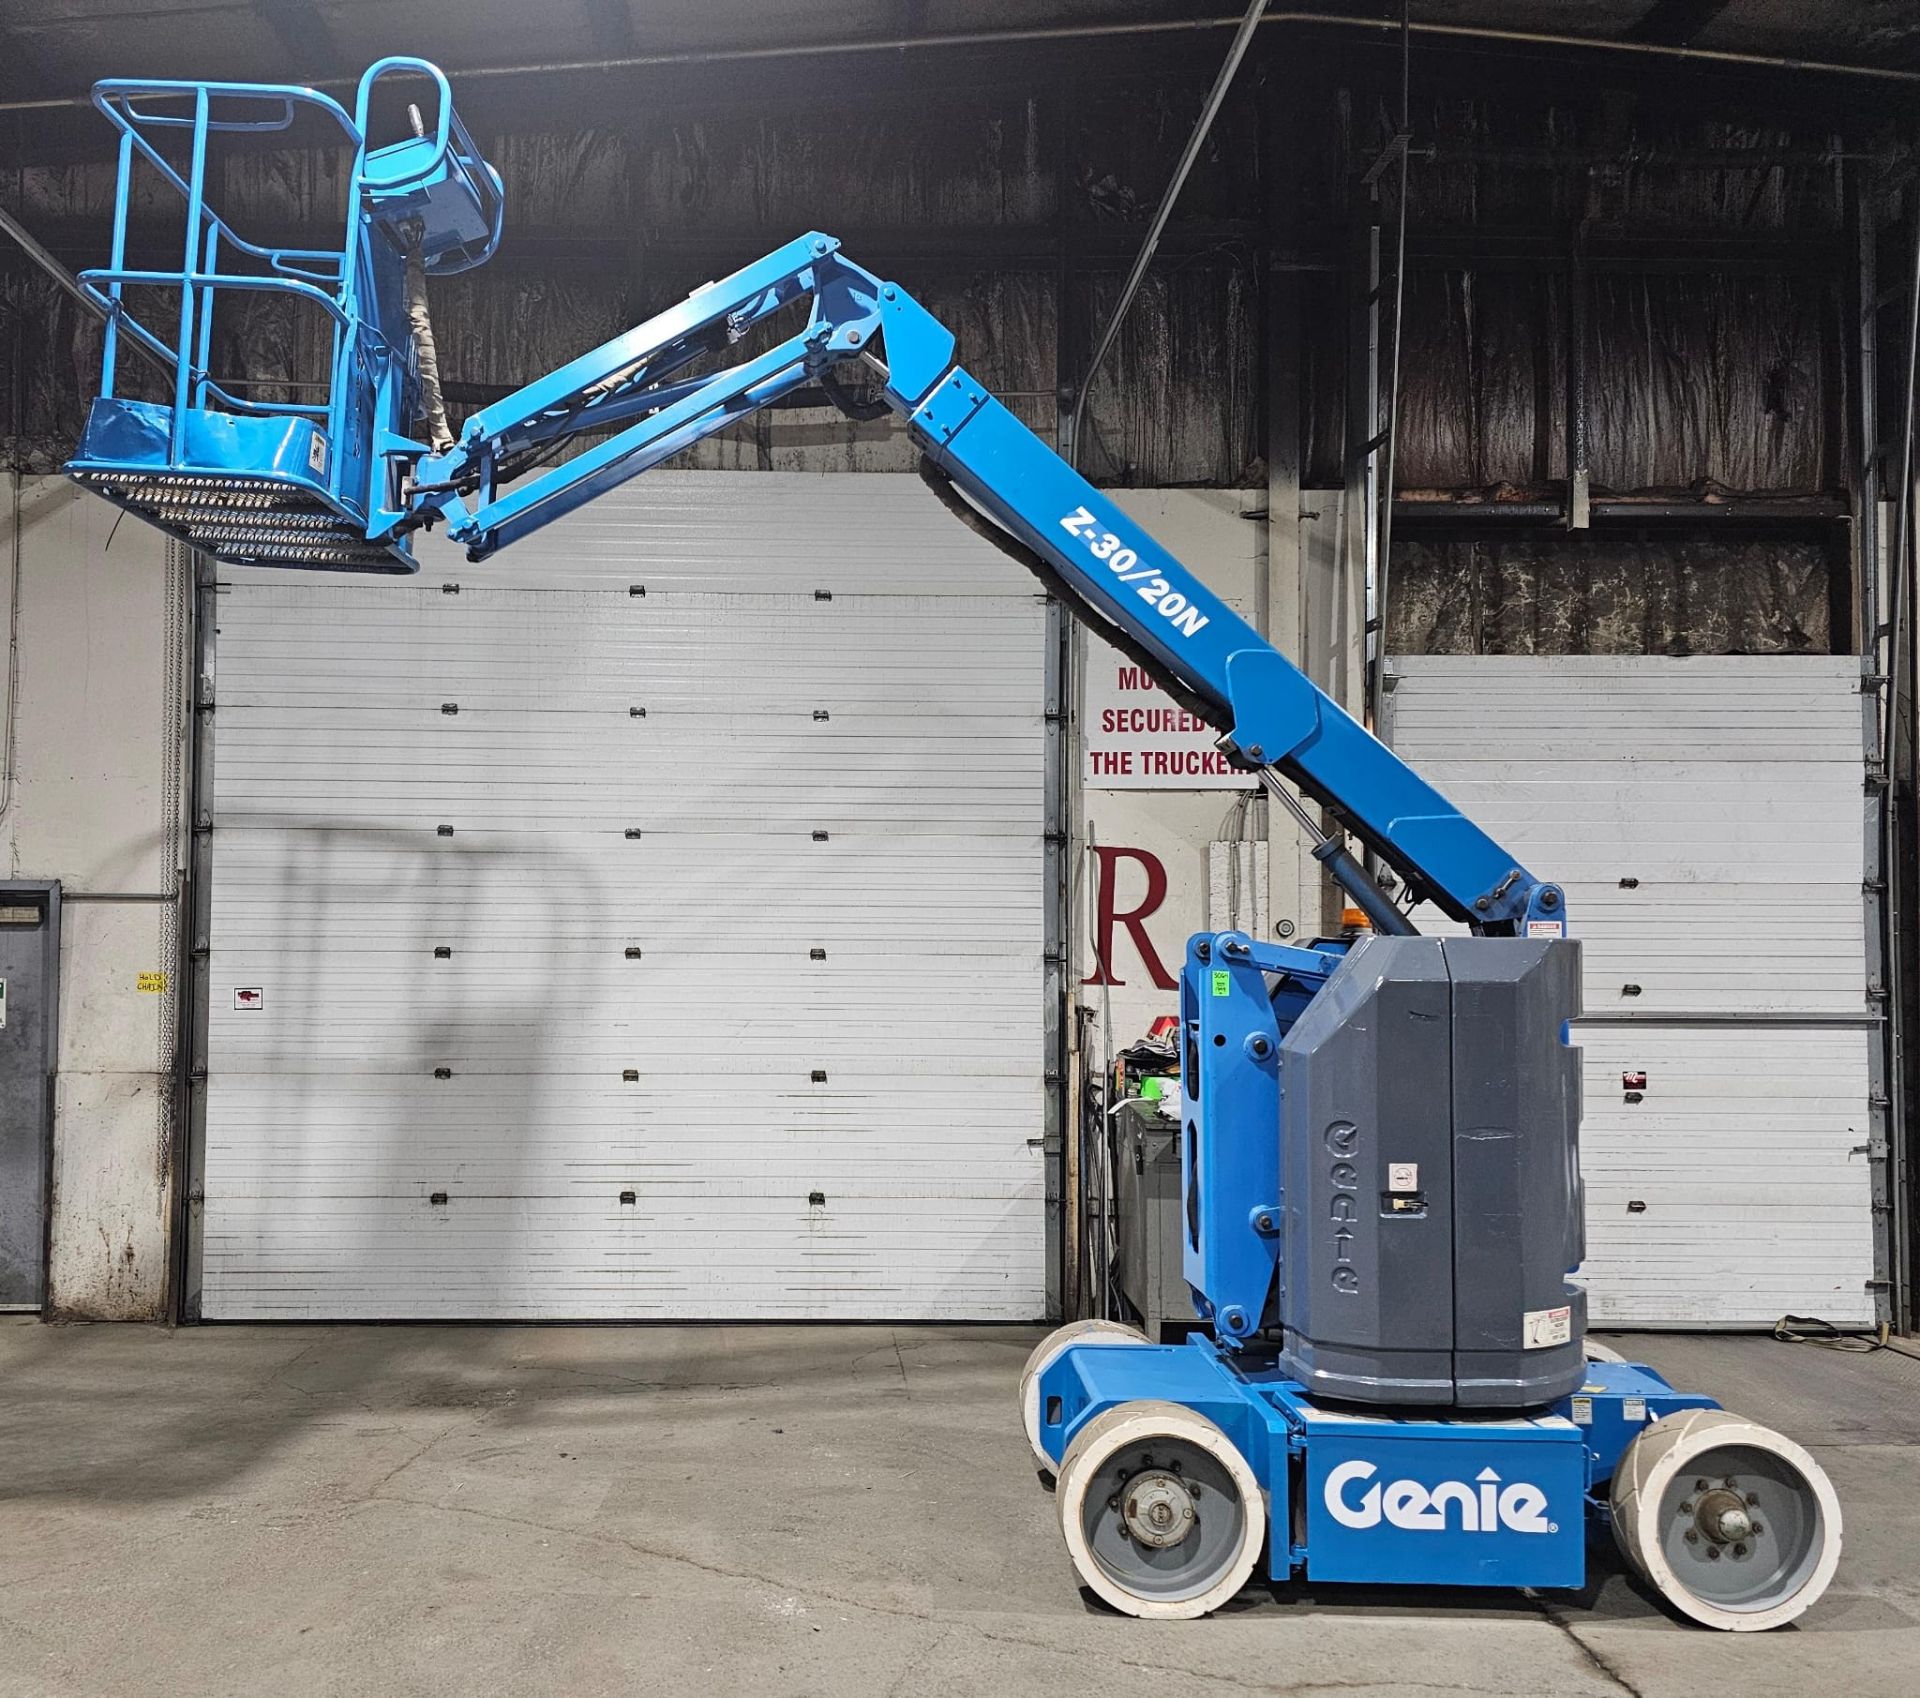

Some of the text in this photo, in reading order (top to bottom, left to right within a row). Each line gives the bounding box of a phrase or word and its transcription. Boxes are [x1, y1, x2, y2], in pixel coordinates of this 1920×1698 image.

[1059, 506, 1210, 638] Z-30/20N
[1118, 666, 1158, 690] MU
[1102, 708, 1206, 733] SECURED
[1090, 750, 1252, 775] THE TRUCKE
[1081, 846, 1179, 991] R
[1324, 1460, 1548, 1533] Genie
